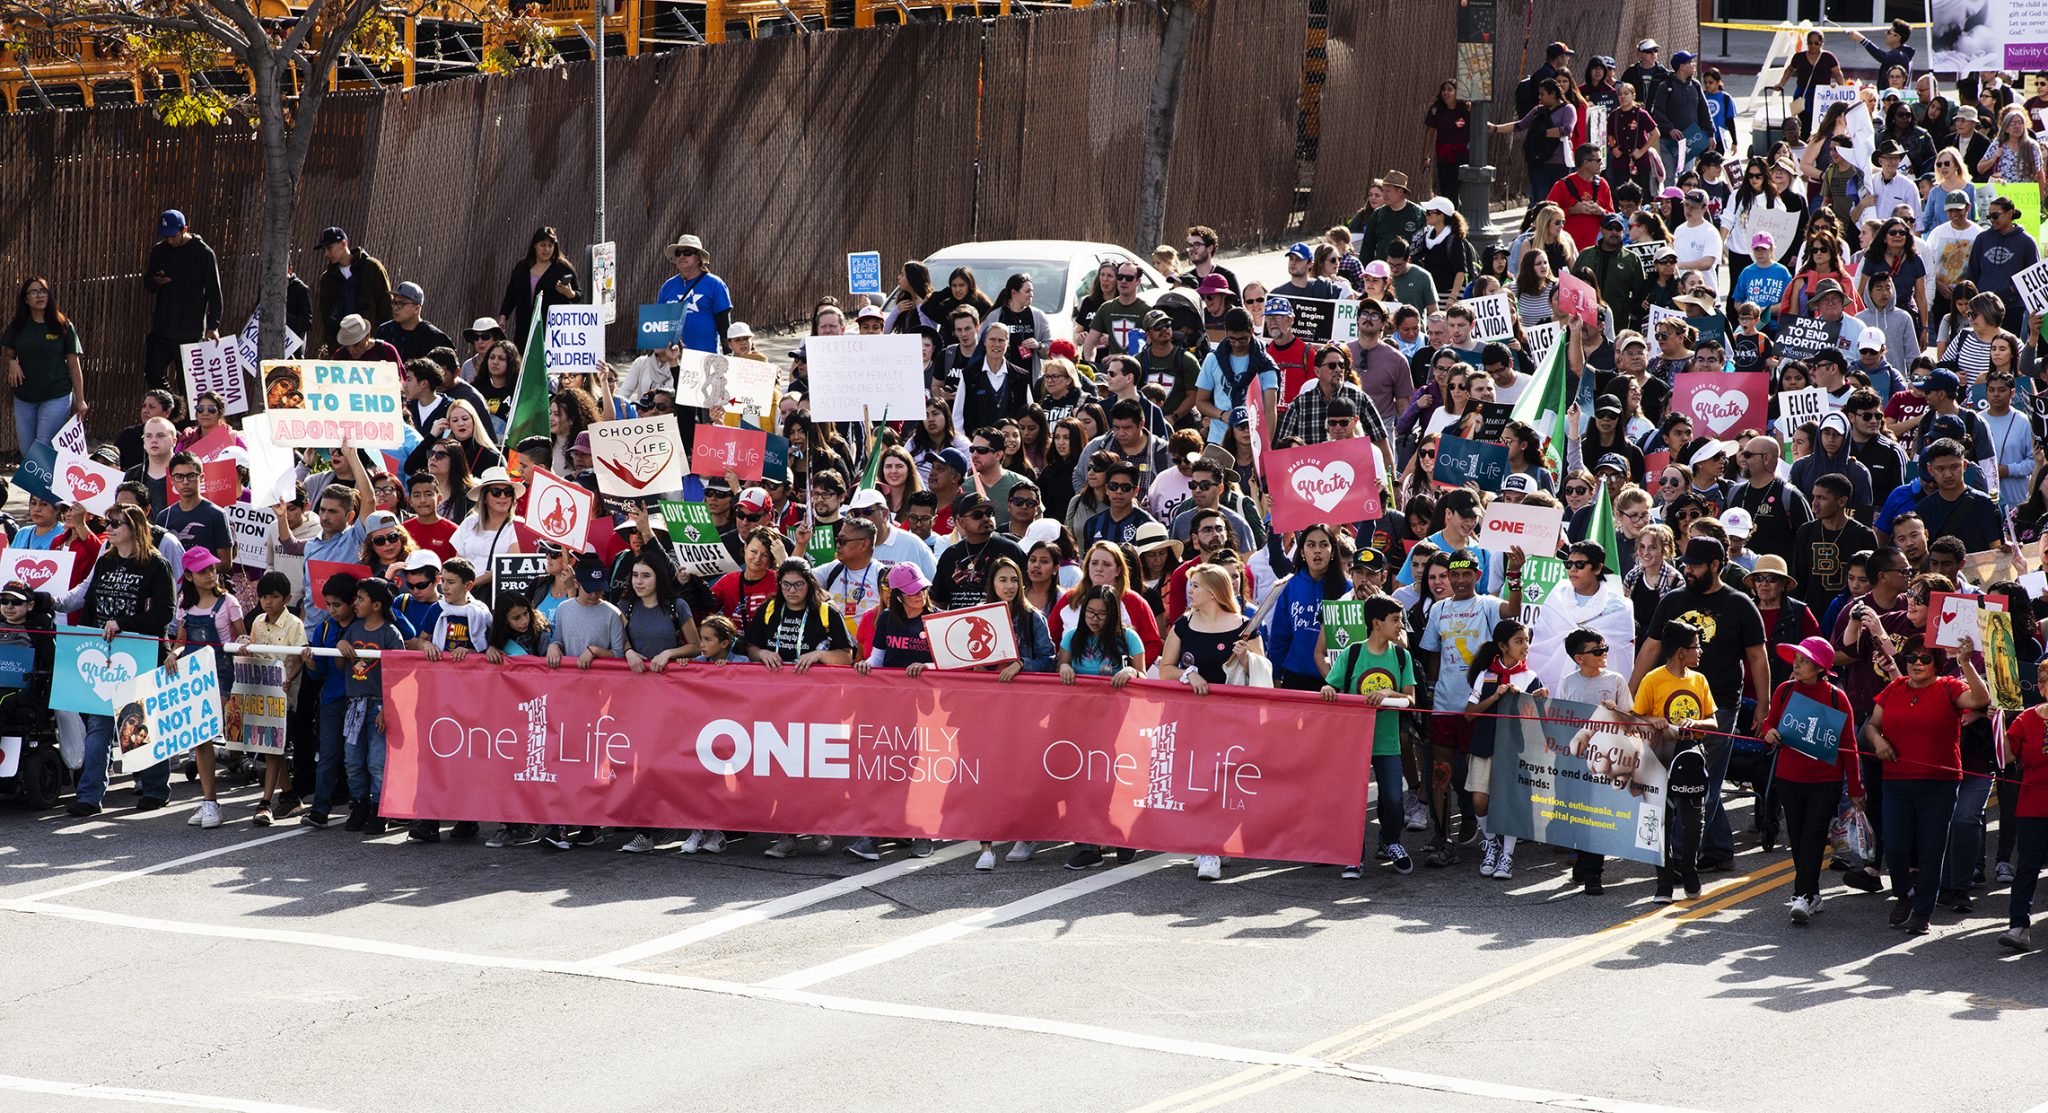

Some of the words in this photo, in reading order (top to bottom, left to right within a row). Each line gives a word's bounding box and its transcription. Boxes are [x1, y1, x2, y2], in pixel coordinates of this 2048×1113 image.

[2008, 47, 2041, 58] Nativity
[1840, 90, 1856, 101] IUD
[852, 257, 877, 266] PEACE
[1296, 304, 1317, 312] Peace
[1301, 312, 1325, 320] Begins
[1338, 304, 1358, 319] PRA
[642, 321, 669, 333] ONE
[1483, 316, 1509, 337] VIDA
[1796, 317, 1826, 330] PRAY
[551, 330, 586, 348] KILLS
[1776, 334, 1835, 350] ABORTION
[1788, 326, 1804, 337] TO
[1806, 329, 1829, 341] END
[545, 349, 596, 368] CHILDREN
[224, 346, 241, 404] Women
[315, 366, 375, 384] PRAY
[1691, 384, 1706, 395] MADE
[307, 393, 339, 411] TO
[350, 394, 395, 413] END
[1696, 401, 1744, 421] greater
[1788, 393, 1819, 416] ELIGE
[59, 422, 82, 448] Abor
[275, 420, 394, 441] ABORTION
[599, 422, 665, 438] CHOOSE
[634, 442, 667, 455] LIFE
[697, 444, 725, 459] One
[722, 441, 737, 466] 1
[738, 448, 759, 466] Life
[24, 460, 53, 483] One
[1288, 458, 1305, 472] MADE
[1440, 453, 1467, 470] One
[1464, 454, 1480, 478] 1
[1480, 461, 1500, 479] Life
[67, 472, 100, 492] greater
[1297, 472, 1351, 503] greater
[229, 506, 245, 519] TO
[247, 510, 275, 525] END
[661, 503, 687, 523] LOVE
[688, 504, 711, 524] LIFE
[235, 521, 265, 538] TION
[1488, 519, 1524, 534] ONE
[809, 528, 832, 550] LIFE
[679, 544, 724, 564] CHOOSE
[16, 565, 53, 583] greater
[501, 559, 512, 575] I
[695, 561, 723, 575] LIFE
[101, 571, 143, 584] CHRIST
[501, 581, 529, 590] PRO-
[1291, 601, 1305, 617] Be
[1322, 604, 1341, 626] LOVE
[1342, 604, 1363, 625] LIFE
[1294, 615, 1309, 631] for
[76, 641, 93, 652] MADE
[886, 635, 909, 649] ONE
[189, 655, 201, 675] A
[81, 662, 131, 689] greater
[146, 671, 215, 716] PERSON
[157, 705, 191, 736] NOT
[201, 699, 213, 719] A
[267, 697, 286, 719] THE
[153, 717, 219, 760] CHOICE
[243, 723, 284, 749] FUTURE
[429, 716, 517, 760] One
[514, 694, 557, 782] 1
[559, 715, 631, 779] Life
[857, 724, 960, 753] FAMILY
[1624, 727, 1656, 742] Scho
[1783, 713, 1806, 733] One
[1801, 716, 1818, 744] 1
[1816, 727, 1836, 748] Life
[696, 719, 850, 779] ONE
[1545, 736, 1571, 757] Pro
[1576, 741, 1602, 763] Life
[1608, 745, 1642, 769] Club
[601, 768, 616, 780] LA
[857, 754, 980, 785] MISSION
[1043, 740, 1137, 786] One
[1134, 720, 1184, 811] 1
[1187, 745, 1262, 808] Life
[1519, 759, 1545, 774] Prays
[1548, 765, 1558, 776] to
[1561, 767, 1580, 780] end
[1582, 770, 1611, 785] death
[1613, 777, 1628, 790] by
[1518, 774, 1550, 790] hands:
[1672, 784, 1705, 795] adidas
[1229, 799, 1245, 811] LA
[1541, 809, 1569, 823] capital
[1569, 815, 1618, 831] punishment.
[1616, 809, 1632, 821] and
